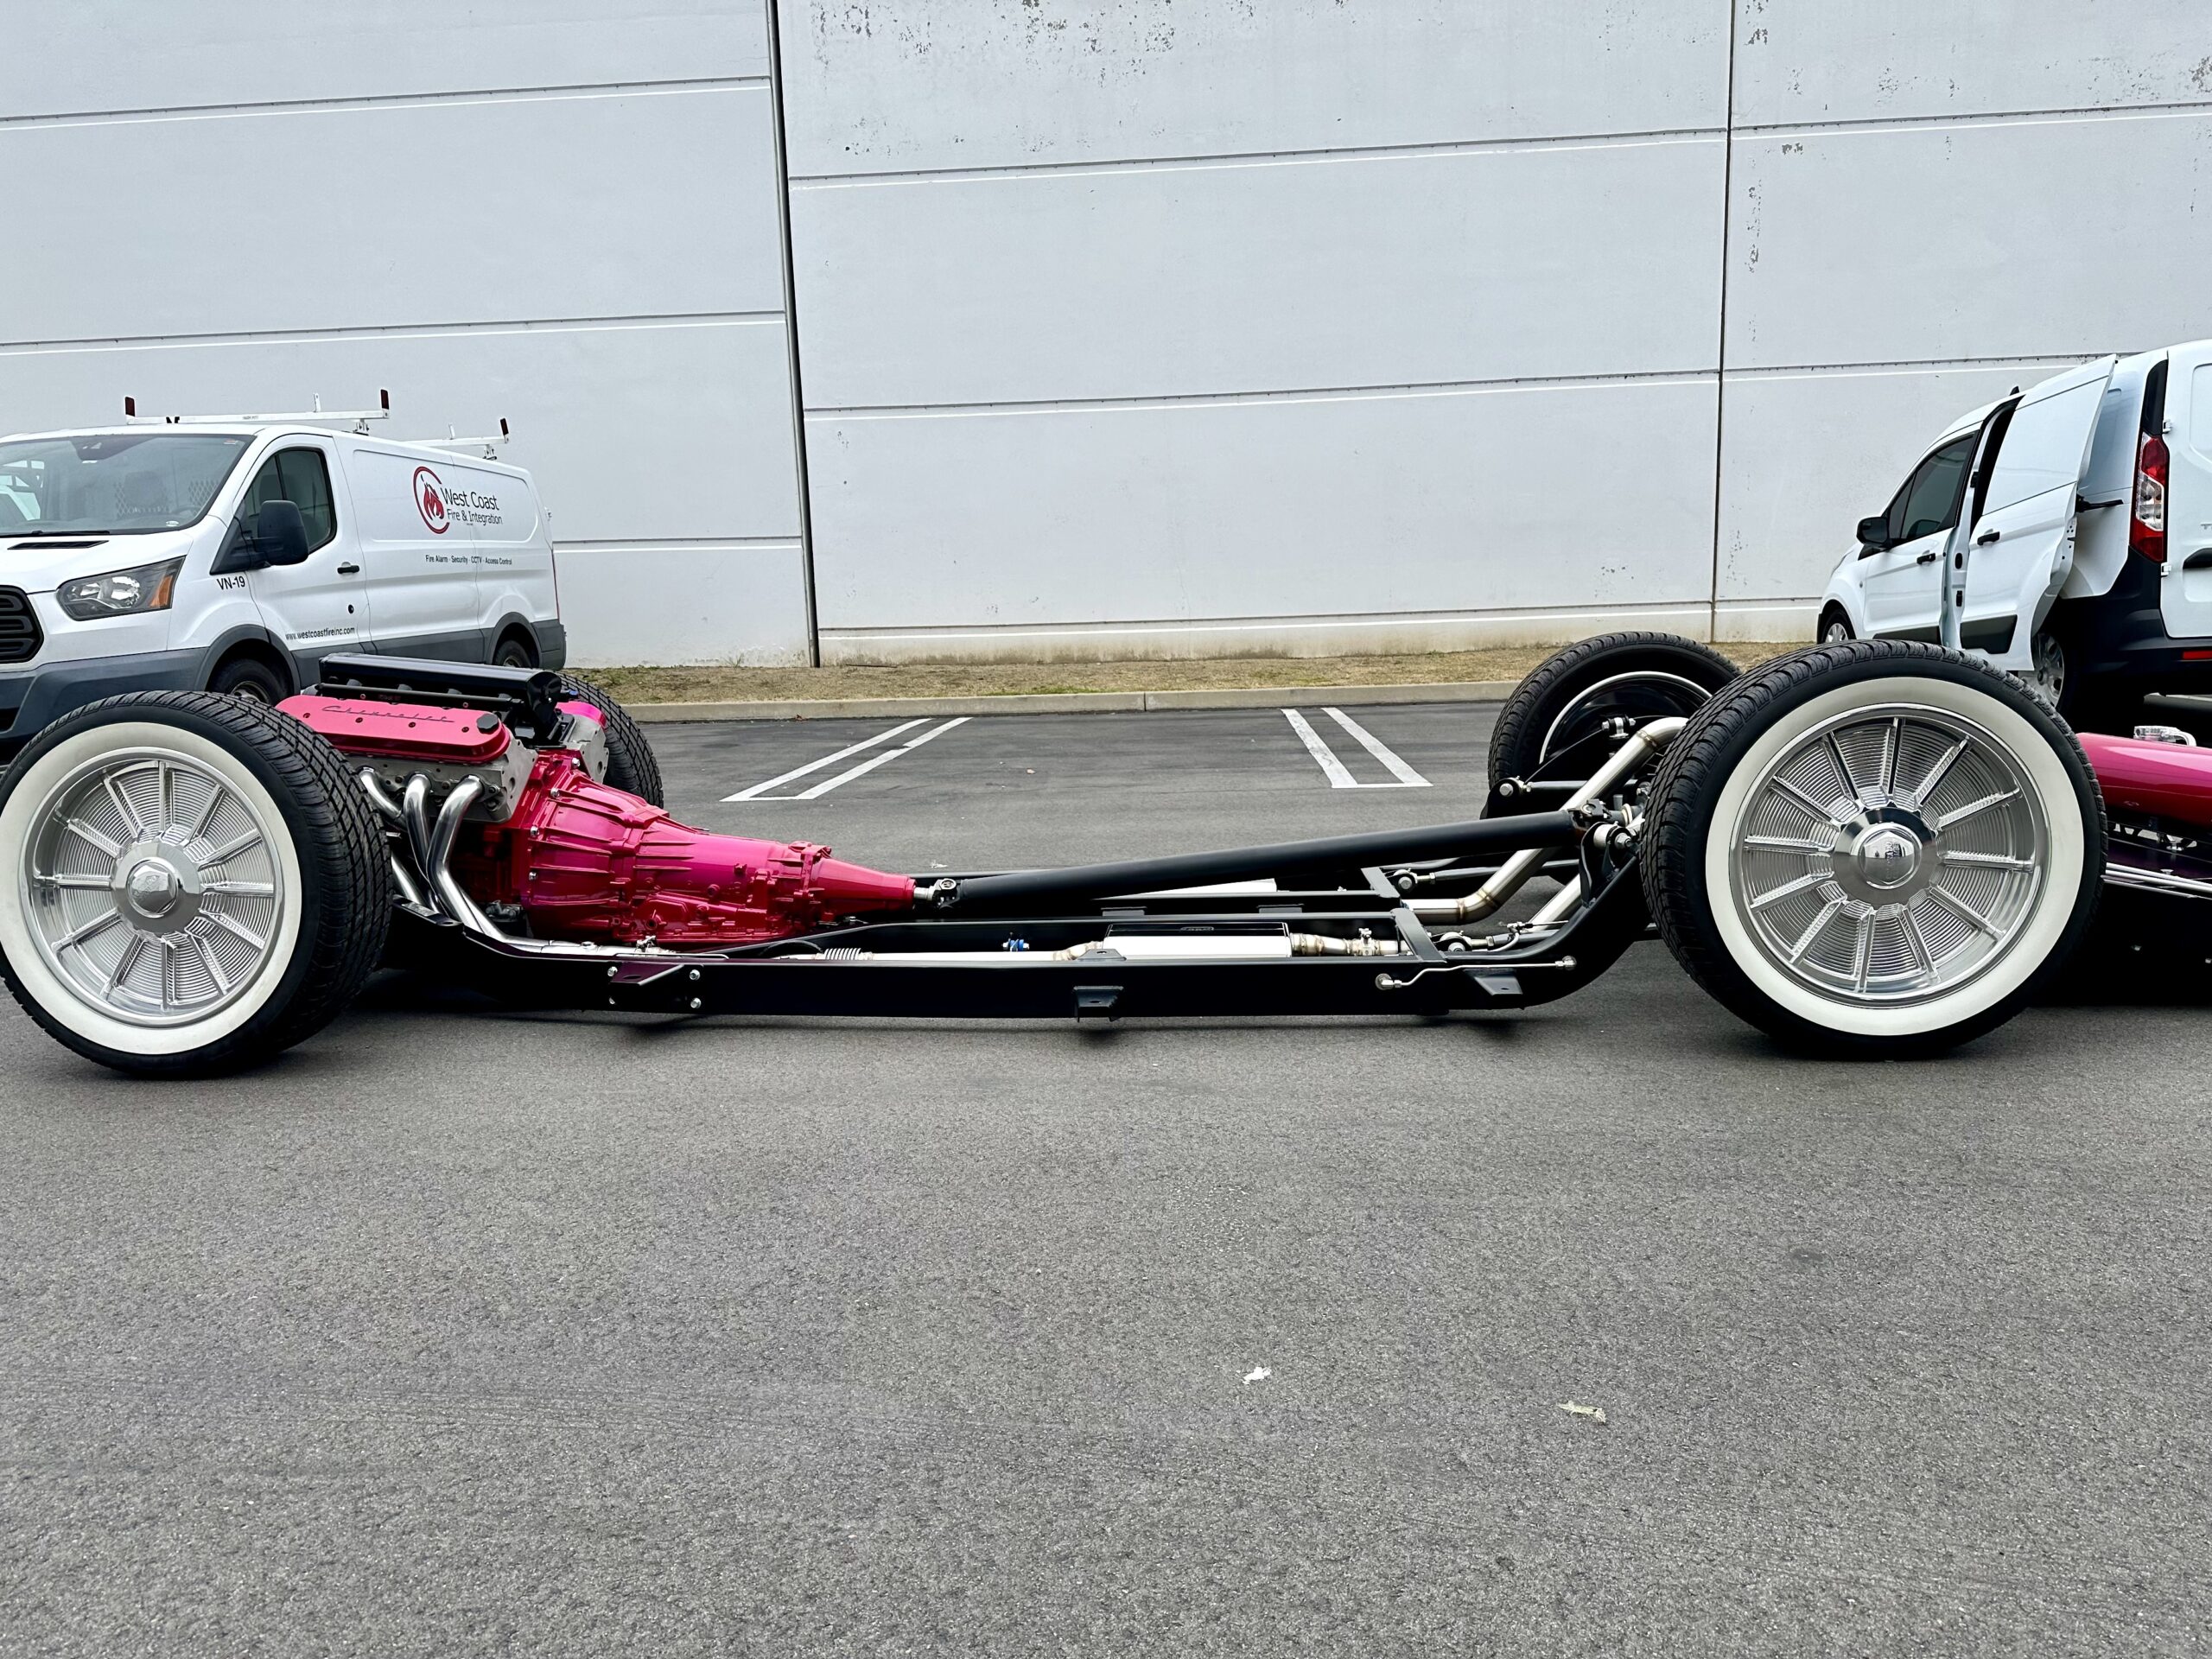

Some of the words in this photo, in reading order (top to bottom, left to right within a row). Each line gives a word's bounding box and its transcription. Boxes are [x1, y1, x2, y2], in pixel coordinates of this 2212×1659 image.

[440, 487, 470, 507] West
[470, 491, 499, 511] Coast
[447, 508, 461, 521] Fire
[461, 510, 467, 521] &
[468, 511, 502, 525] Integration
[435, 555, 448, 563] Alarm
[451, 556, 467, 564] Security
[471, 556, 482, 564] CCTV
[216, 575, 245, 590] VN-19
[285, 627, 355, 640] www.westcoastfireinc.com
[321, 706, 454, 722] Chevrolet
